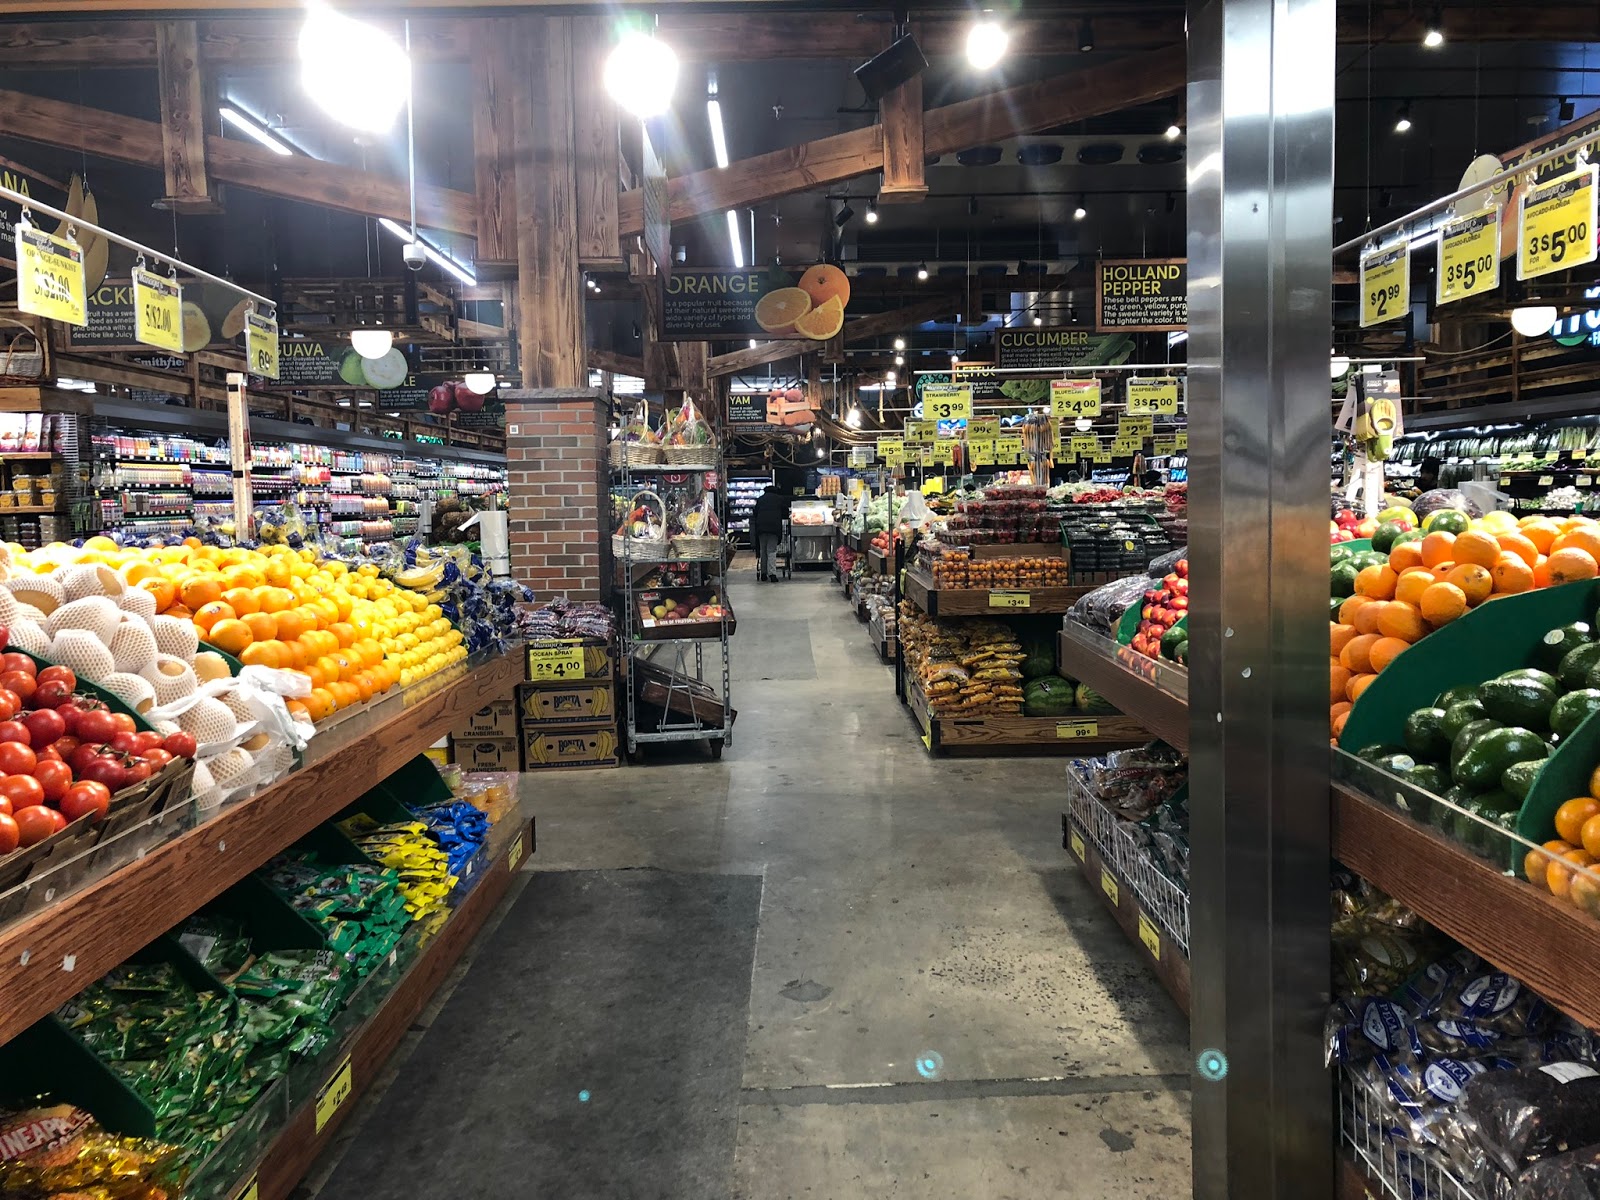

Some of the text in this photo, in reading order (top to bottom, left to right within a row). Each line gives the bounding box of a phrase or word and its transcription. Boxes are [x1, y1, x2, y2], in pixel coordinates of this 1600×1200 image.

[1491, 124, 1600, 195] CANTALOU
[1528, 181, 1567, 203] Manager's
[1527, 199, 1570, 220] AVOCADO-FLORIDA
[1445, 233, 1481, 250] AVOCADO-FLORIDA
[26, 248, 77, 272] ORNGE-SUNKIST
[1103, 265, 1180, 280] HOLLAND
[666, 275, 758, 294] ORANGE
[1103, 281, 1161, 296] PEPPER
[1141, 296, 1169, 304] peppers
[1144, 303, 1169, 311] yellow,
[1117, 318, 1140, 326] lighter
[1001, 332, 1088, 346] CUCUMBER
[730, 396, 751, 405] YAM
[553, 695, 582, 709] BONITA
[558, 739, 587, 753] BONITA
